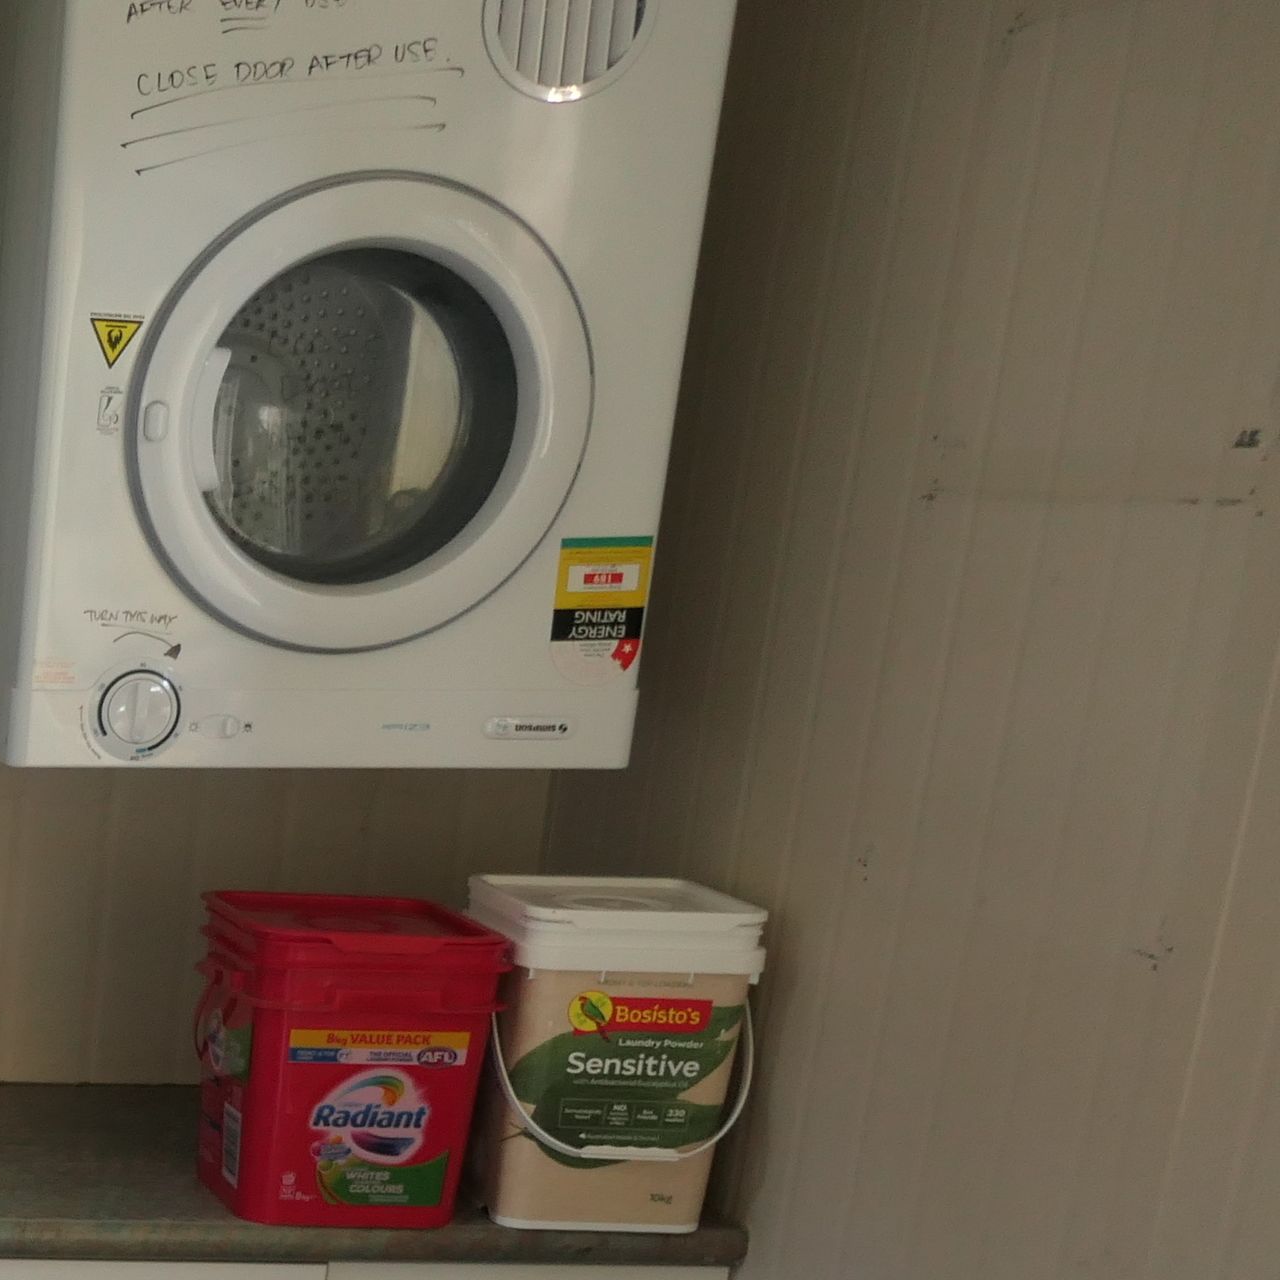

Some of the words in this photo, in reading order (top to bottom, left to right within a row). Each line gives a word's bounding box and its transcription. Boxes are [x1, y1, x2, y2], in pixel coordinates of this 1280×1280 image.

[137, 64, 218, 96] CLOSE
[308, 43, 383, 76] AFTER
[83, 610, 119, 622] TURN
[574, 609, 626, 623] RATING
[568, 625, 626, 639] ENERGY
[615, 1005, 701, 1025] Bosisto's
[351, 1033, 391, 1045] VALUE
[396, 1034, 432, 1046] PACK
[618, 1038, 661, 1050] Laundry
[663, 1041, 704, 1049] Powder
[421, 1053, 454, 1064] AFL
[566, 1051, 700, 1078] Sensitive
[313, 1103, 427, 1129] Radiant
